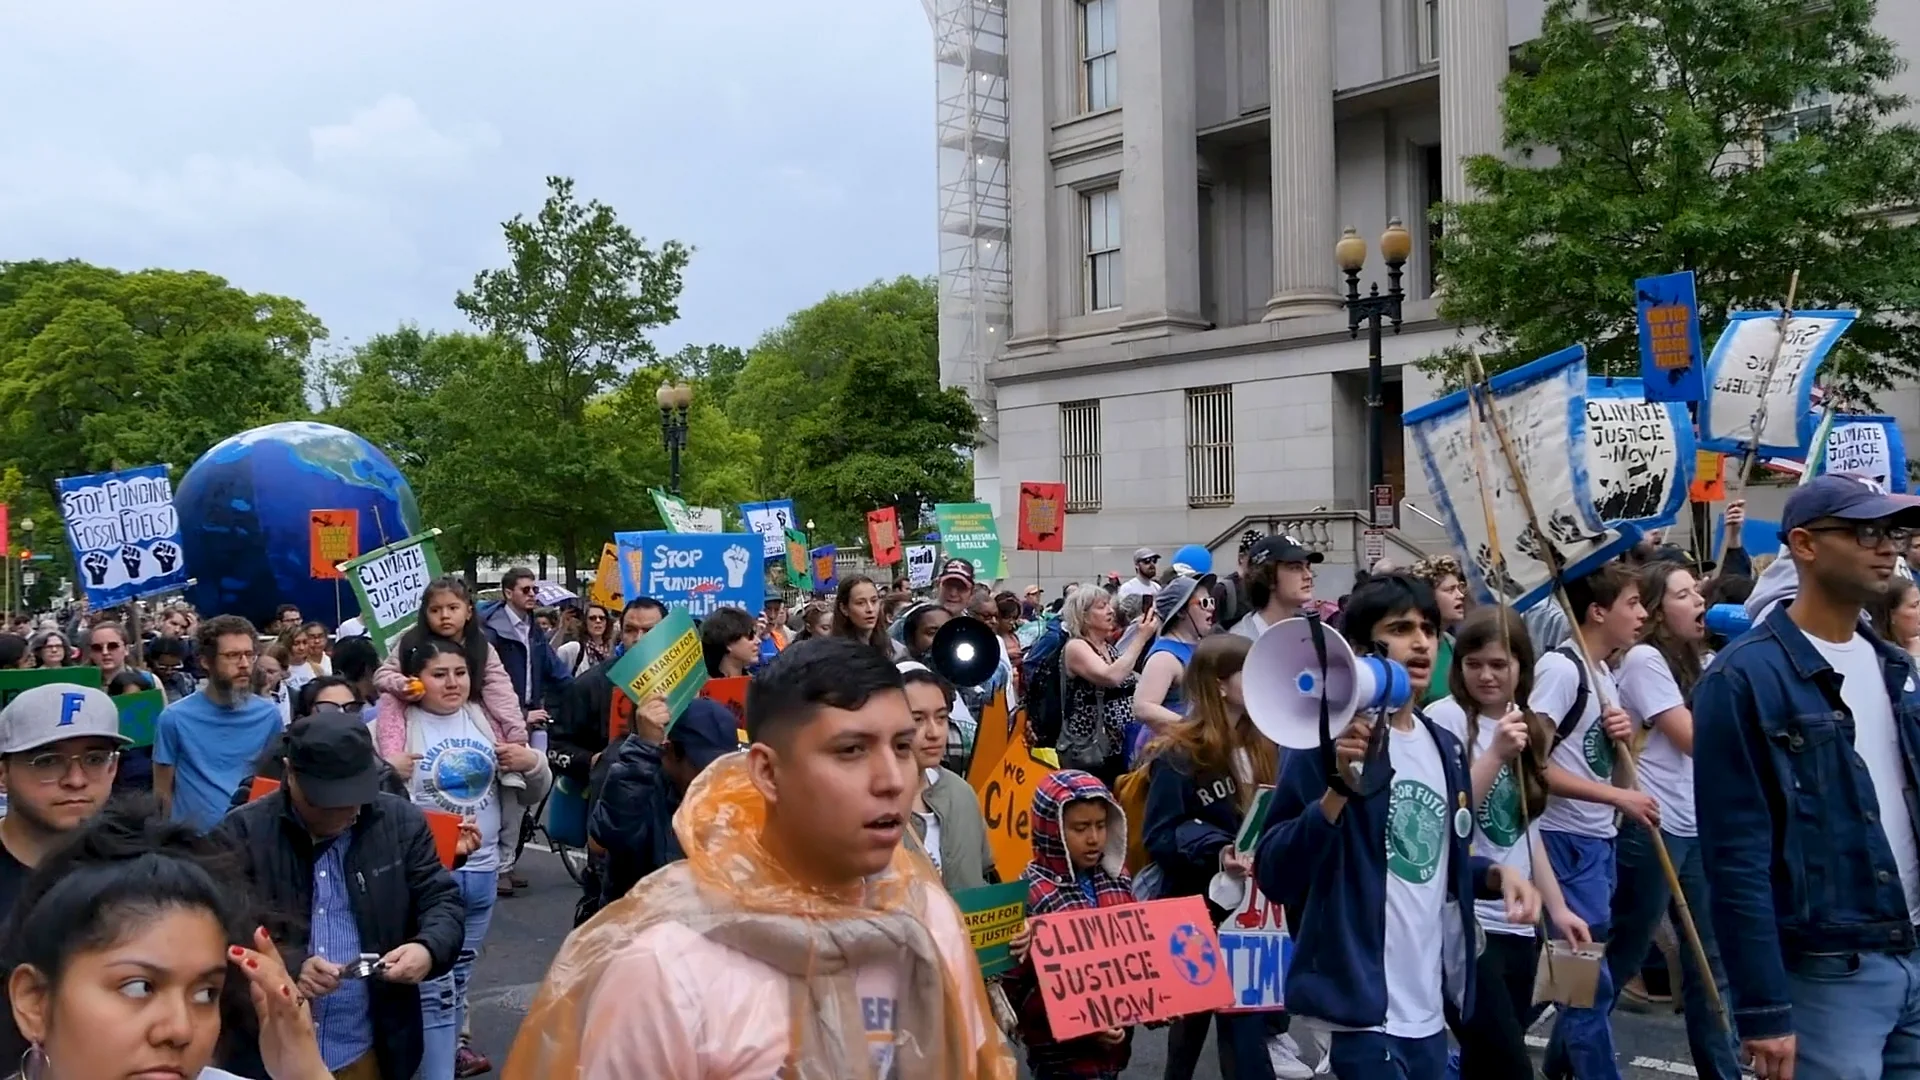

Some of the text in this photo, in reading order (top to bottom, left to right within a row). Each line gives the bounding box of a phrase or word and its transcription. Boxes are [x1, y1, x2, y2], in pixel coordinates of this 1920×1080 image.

[1587, 401, 1665, 422] CLIMATE
[1591, 423, 1665, 447] JUSTICE
[1828, 427, 1881, 446] CLIMATE
[1613, 444, 1658, 463] NOW
[1828, 442, 1880, 462] JUSTICE
[1843, 456, 1875, 471] NOW
[62, 480, 171, 518] STOP FUNDING
[70, 507, 174, 550] FOSSIL FUELS!
[358, 547, 422, 586] CLIMATE
[651, 544, 703, 569] STOP
[366, 572, 422, 608] JUSTICE
[648, 570, 725, 594] FUNDING
[632, 632, 695, 691] WE MARCH FOR
[56, 692, 85, 728] F
[420, 738, 450, 772] CLIMATE
[1415, 786, 1447, 818] FUTU
[965, 905, 1019, 927] ARCH FOR
[980, 923, 1023, 946] JUSTICE
[1032, 908, 1155, 957] CLIMATE
[1044, 950, 1160, 1001] JUSTICE
[1087, 987, 1155, 1028] NOW
